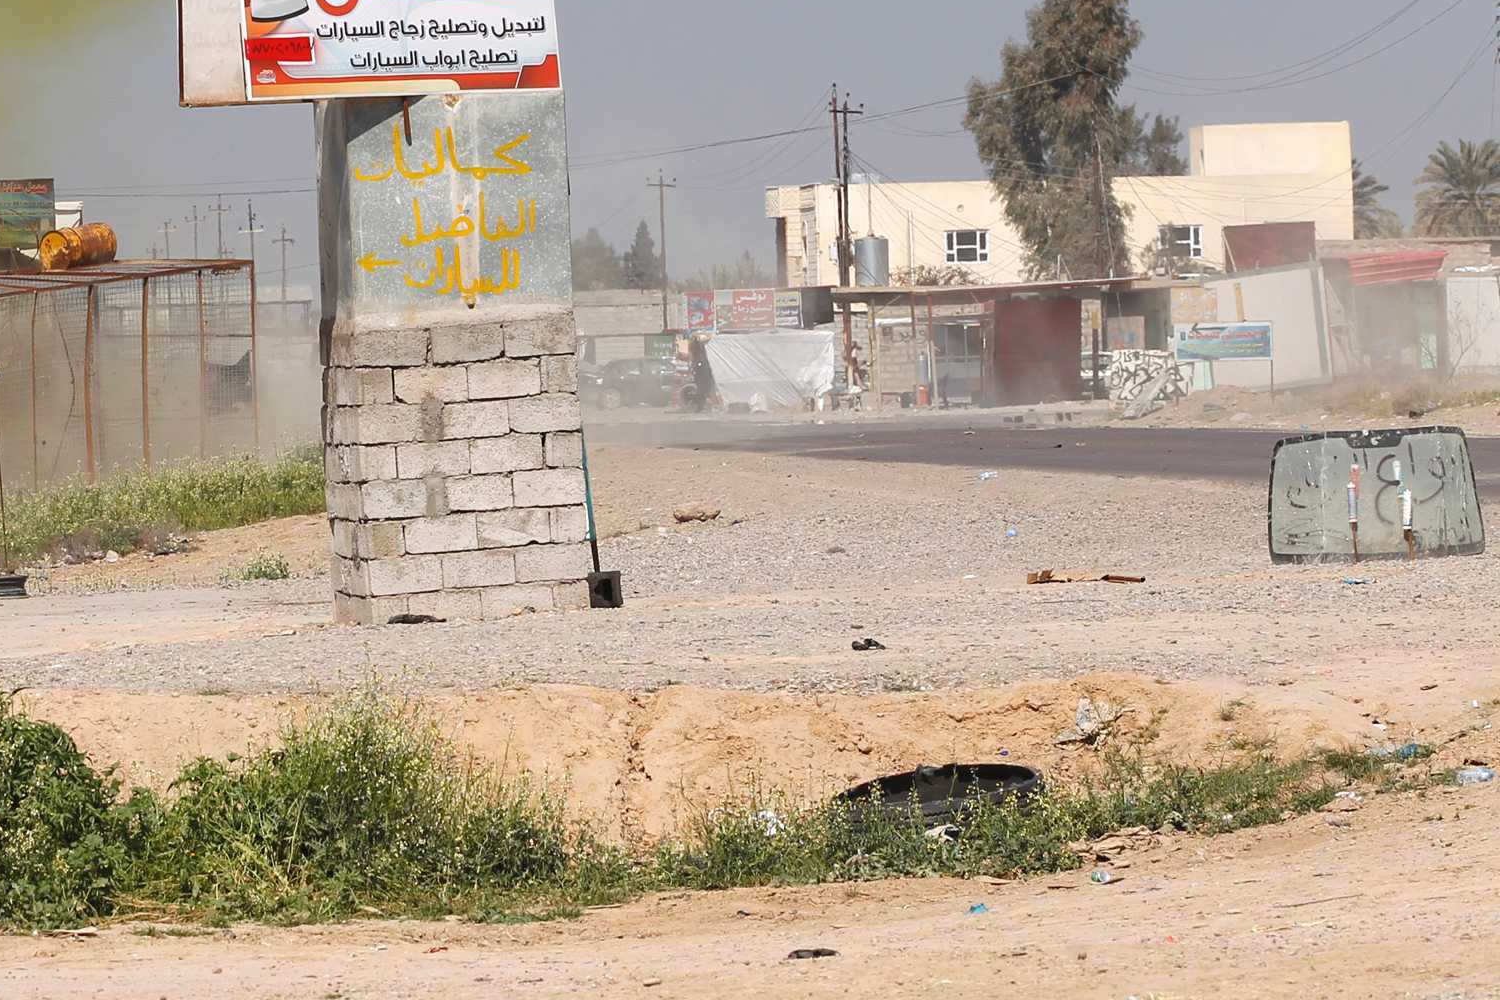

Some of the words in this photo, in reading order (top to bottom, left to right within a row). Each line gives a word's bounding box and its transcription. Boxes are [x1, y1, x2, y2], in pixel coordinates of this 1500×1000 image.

[316, 21, 385, 41] السيارات
[389, 20, 425, 38] زجاج
[428, 19, 488, 39] وتصليح
[492, 16, 546, 38] لتبديل
[350, 51, 418, 71] السيارات
[422, 49, 466, 70] ابواب
[469, 49, 518, 69] تصليح
[355, 123, 533, 187] كماليات
